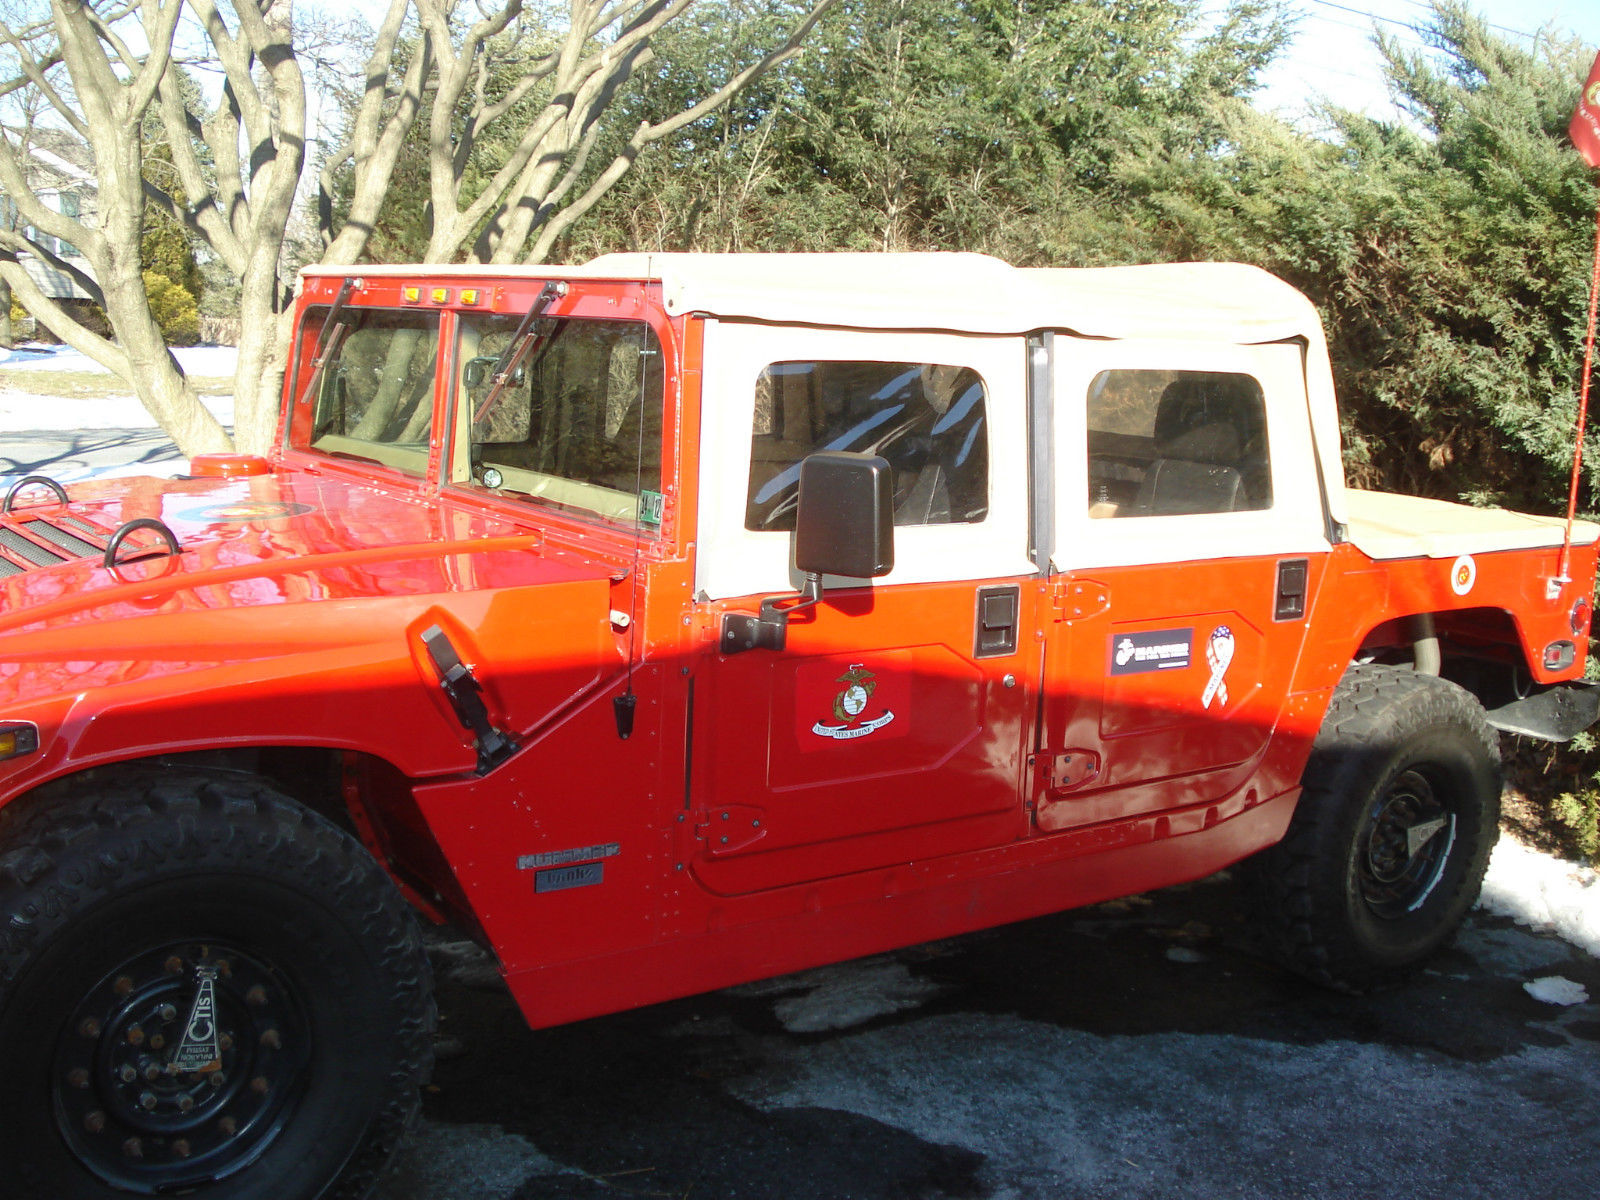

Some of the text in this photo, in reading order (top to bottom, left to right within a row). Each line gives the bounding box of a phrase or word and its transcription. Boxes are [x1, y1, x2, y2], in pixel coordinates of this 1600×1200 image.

[849, 727, 872, 737] MARINE
[872, 714, 893, 728] CORPS
[517, 842, 621, 870] HUMMER
[188, 997, 213, 1041] CTIS
